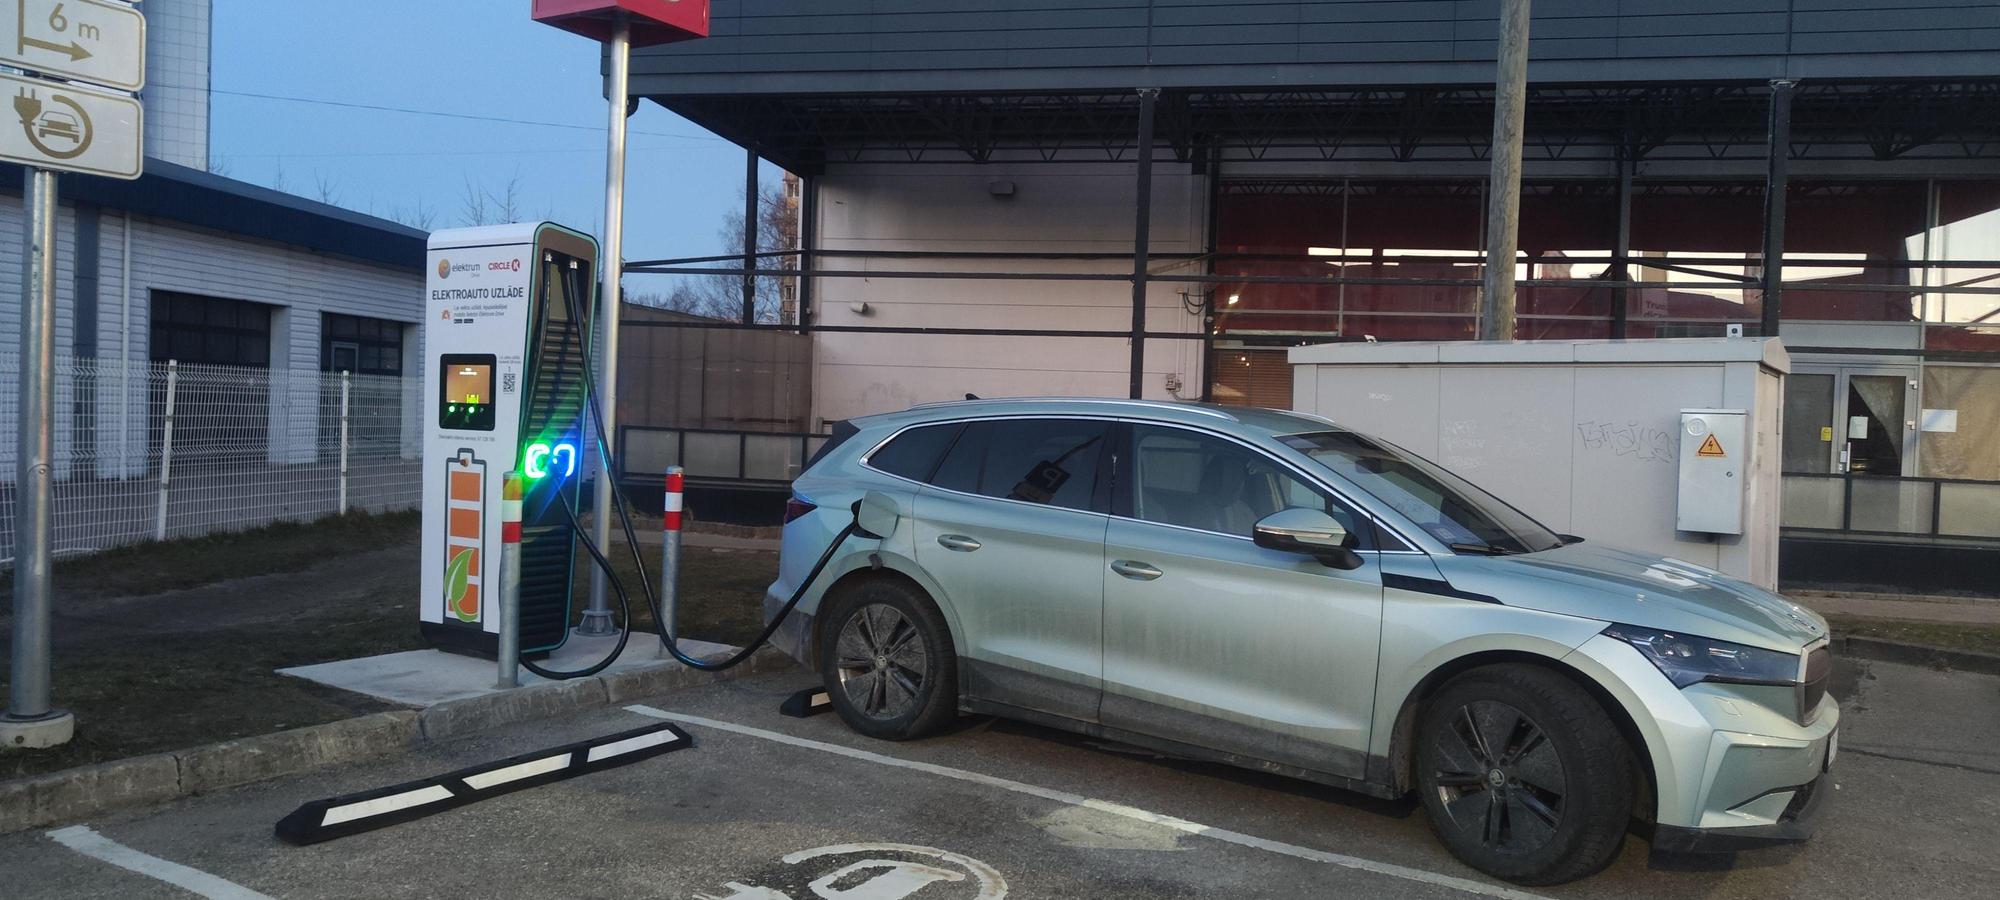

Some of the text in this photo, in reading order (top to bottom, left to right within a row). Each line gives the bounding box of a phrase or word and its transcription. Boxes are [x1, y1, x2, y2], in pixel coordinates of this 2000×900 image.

[49, 3, 100, 41] 6 m
[452, 263, 480, 272] elektrum
[488, 262, 511, 271] CIRCLE
[432, 285, 524, 300] ELEKTROAUTO UZLĀDE
